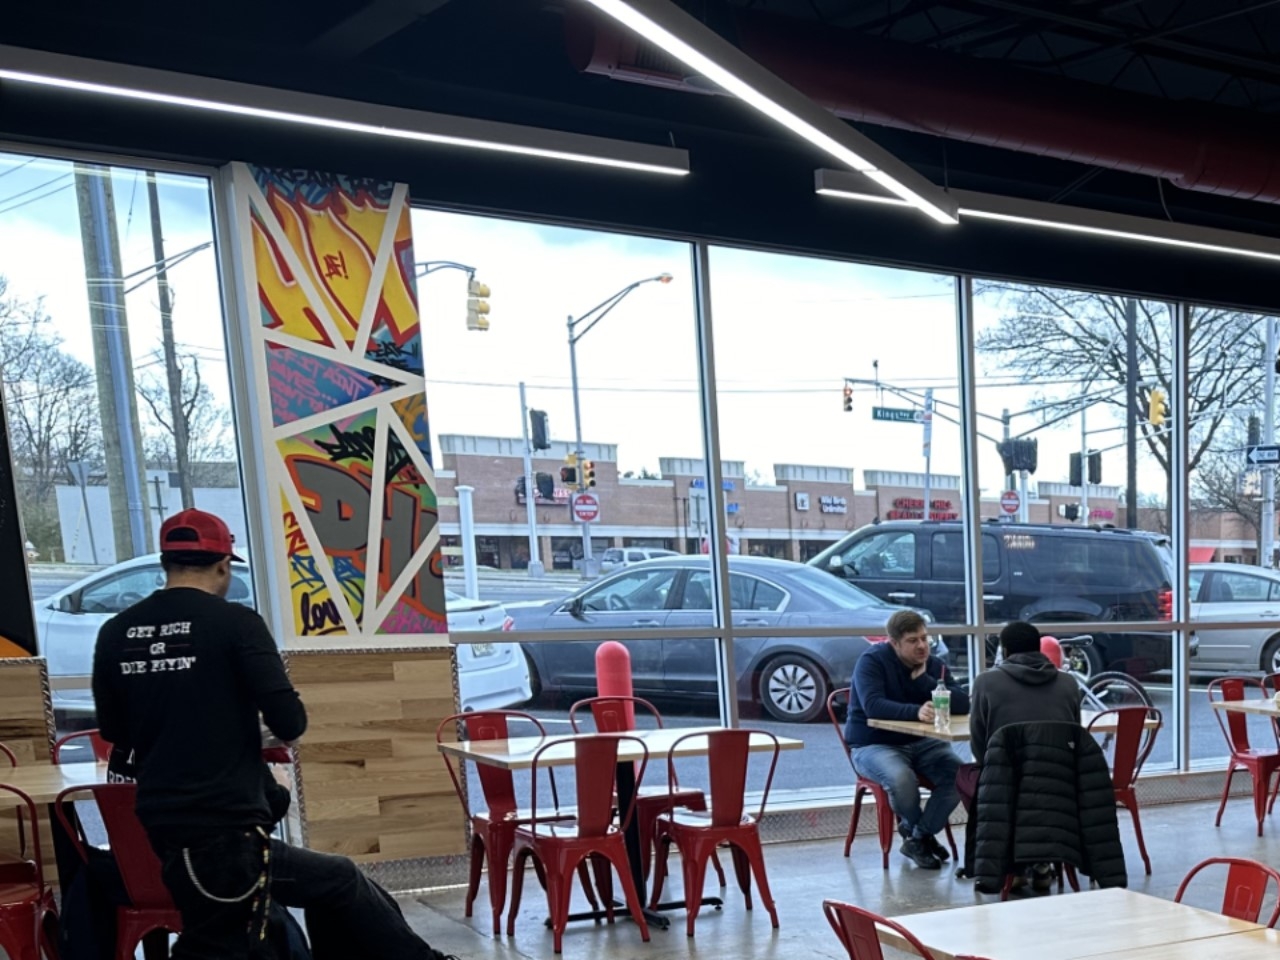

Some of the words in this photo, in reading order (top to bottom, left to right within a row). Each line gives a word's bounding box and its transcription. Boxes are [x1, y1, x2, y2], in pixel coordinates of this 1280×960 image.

[126, 626, 156, 638] GET
[160, 621, 192, 636] RICH
[149, 642, 166, 655] OR
[120, 661, 147, 674] DIE
